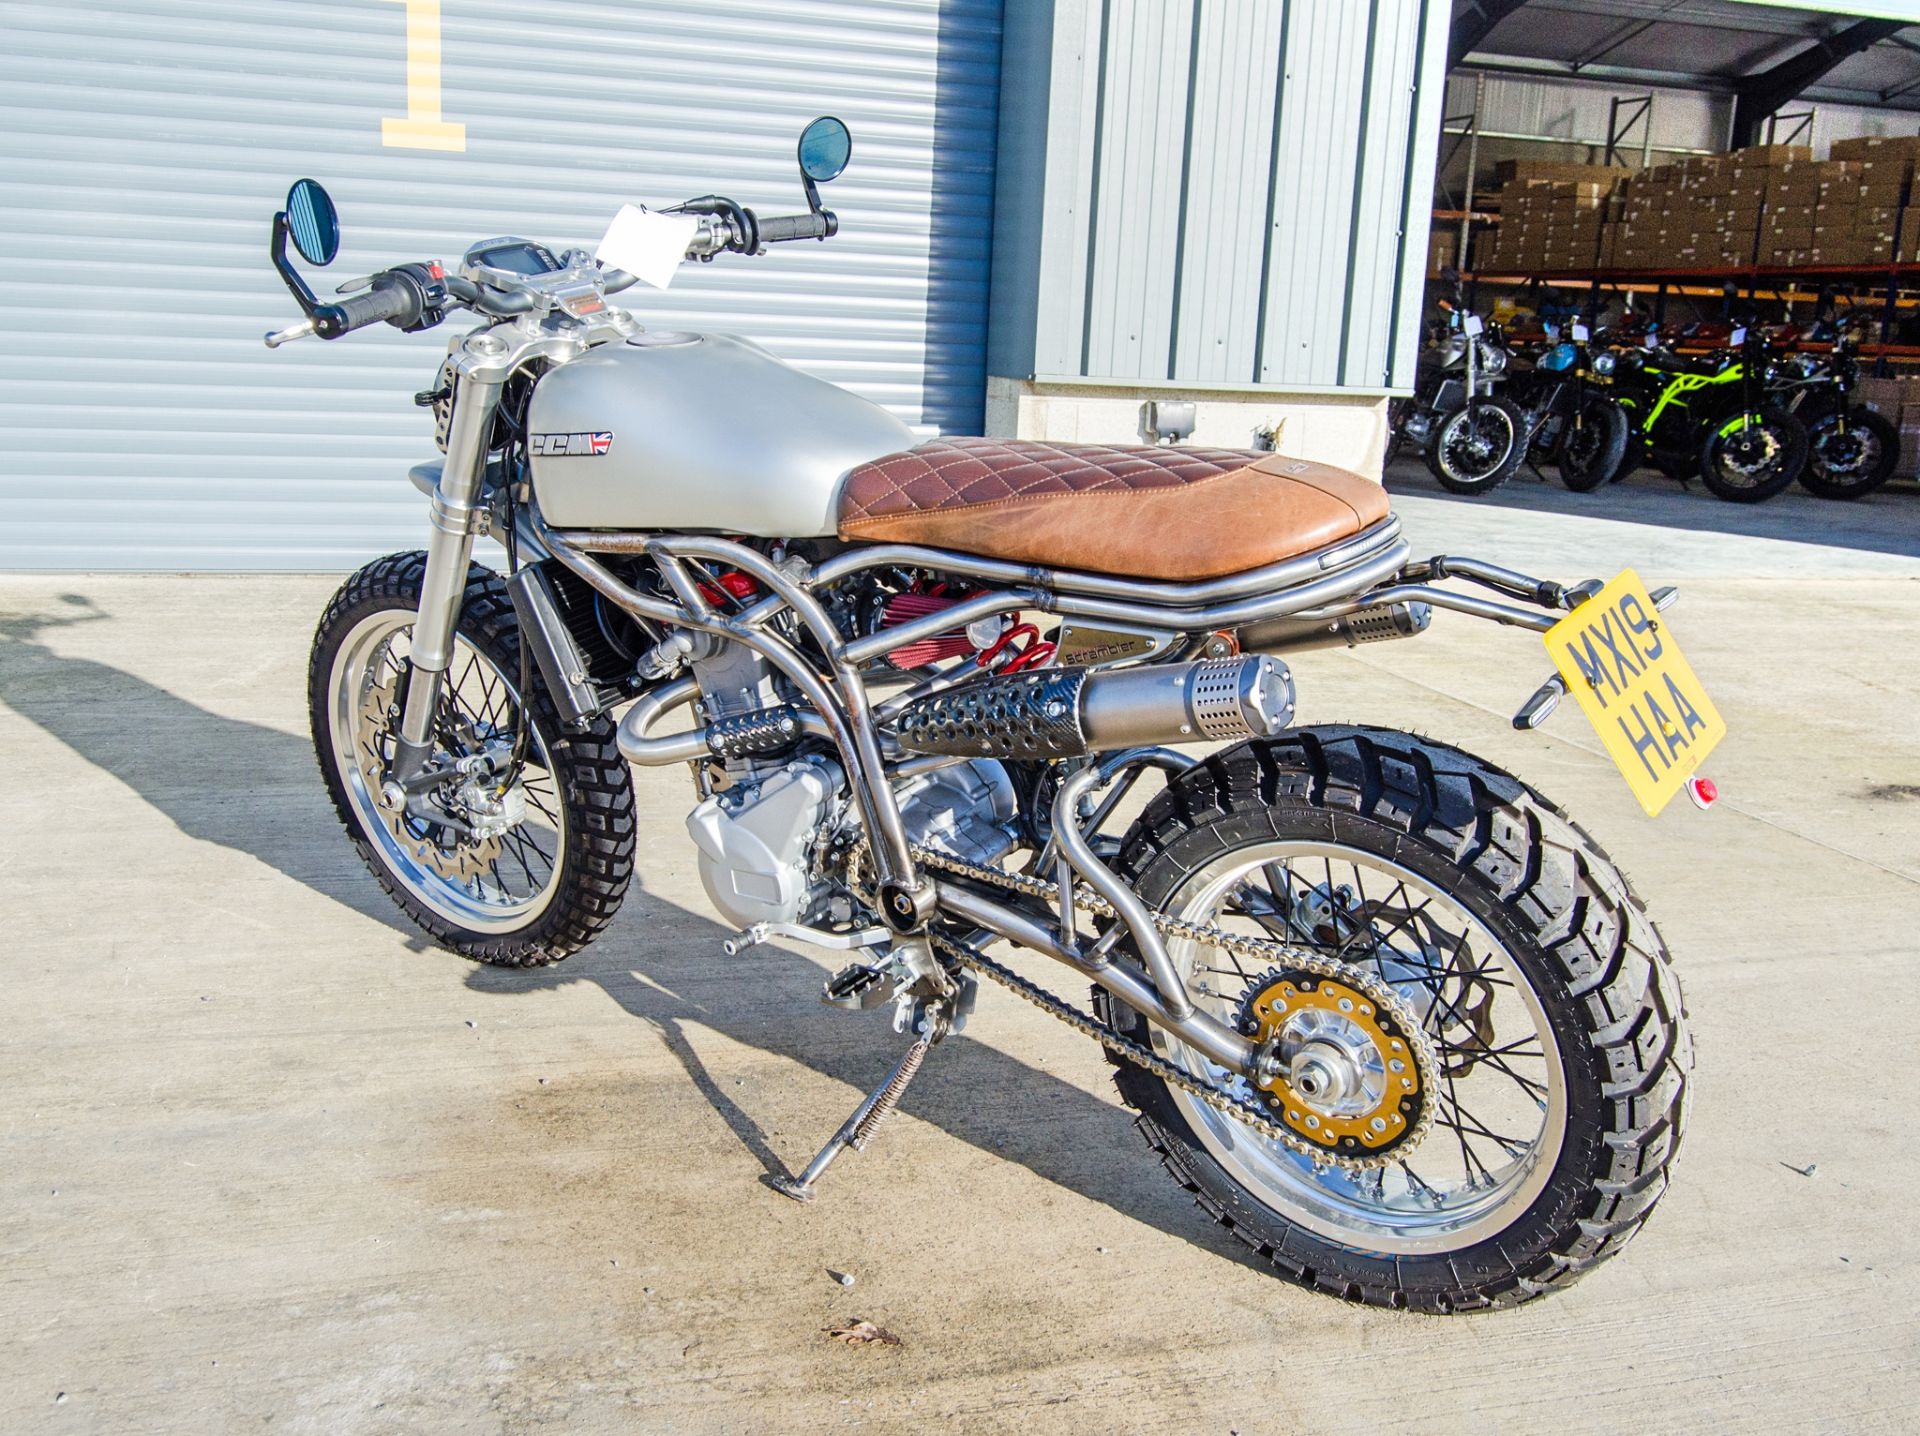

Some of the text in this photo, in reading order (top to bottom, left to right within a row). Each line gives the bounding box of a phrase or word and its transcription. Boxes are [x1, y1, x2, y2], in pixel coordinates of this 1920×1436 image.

[529, 434, 592, 455] CCM
[1566, 593, 1663, 709] MX19
[1617, 672, 1706, 783] HAA
